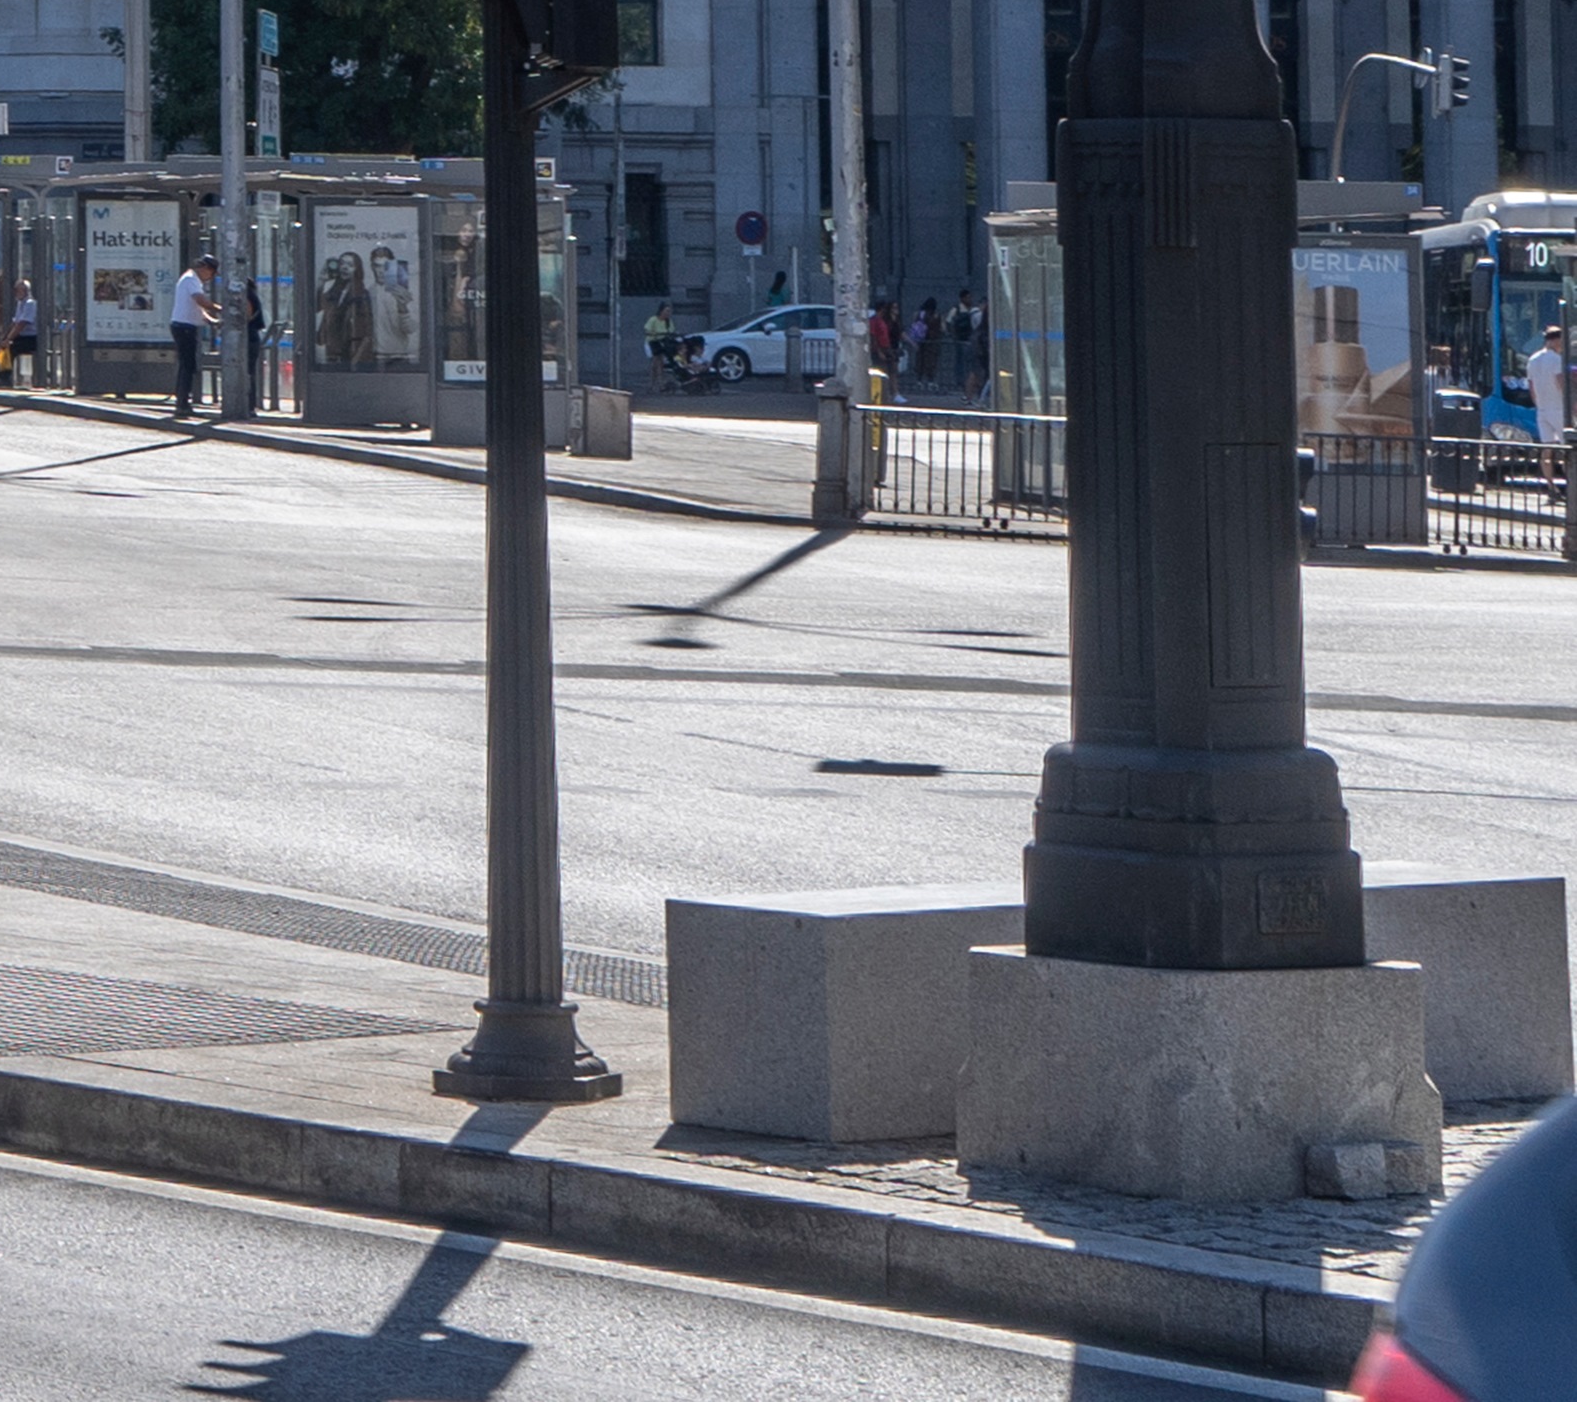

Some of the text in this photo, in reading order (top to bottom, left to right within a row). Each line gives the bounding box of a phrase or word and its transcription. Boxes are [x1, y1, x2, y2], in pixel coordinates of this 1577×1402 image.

[93, 231, 173, 248] Hat-trick
[1292, 252, 1400, 273] UERLAIN
[1526, 242, 1548, 267] 10
